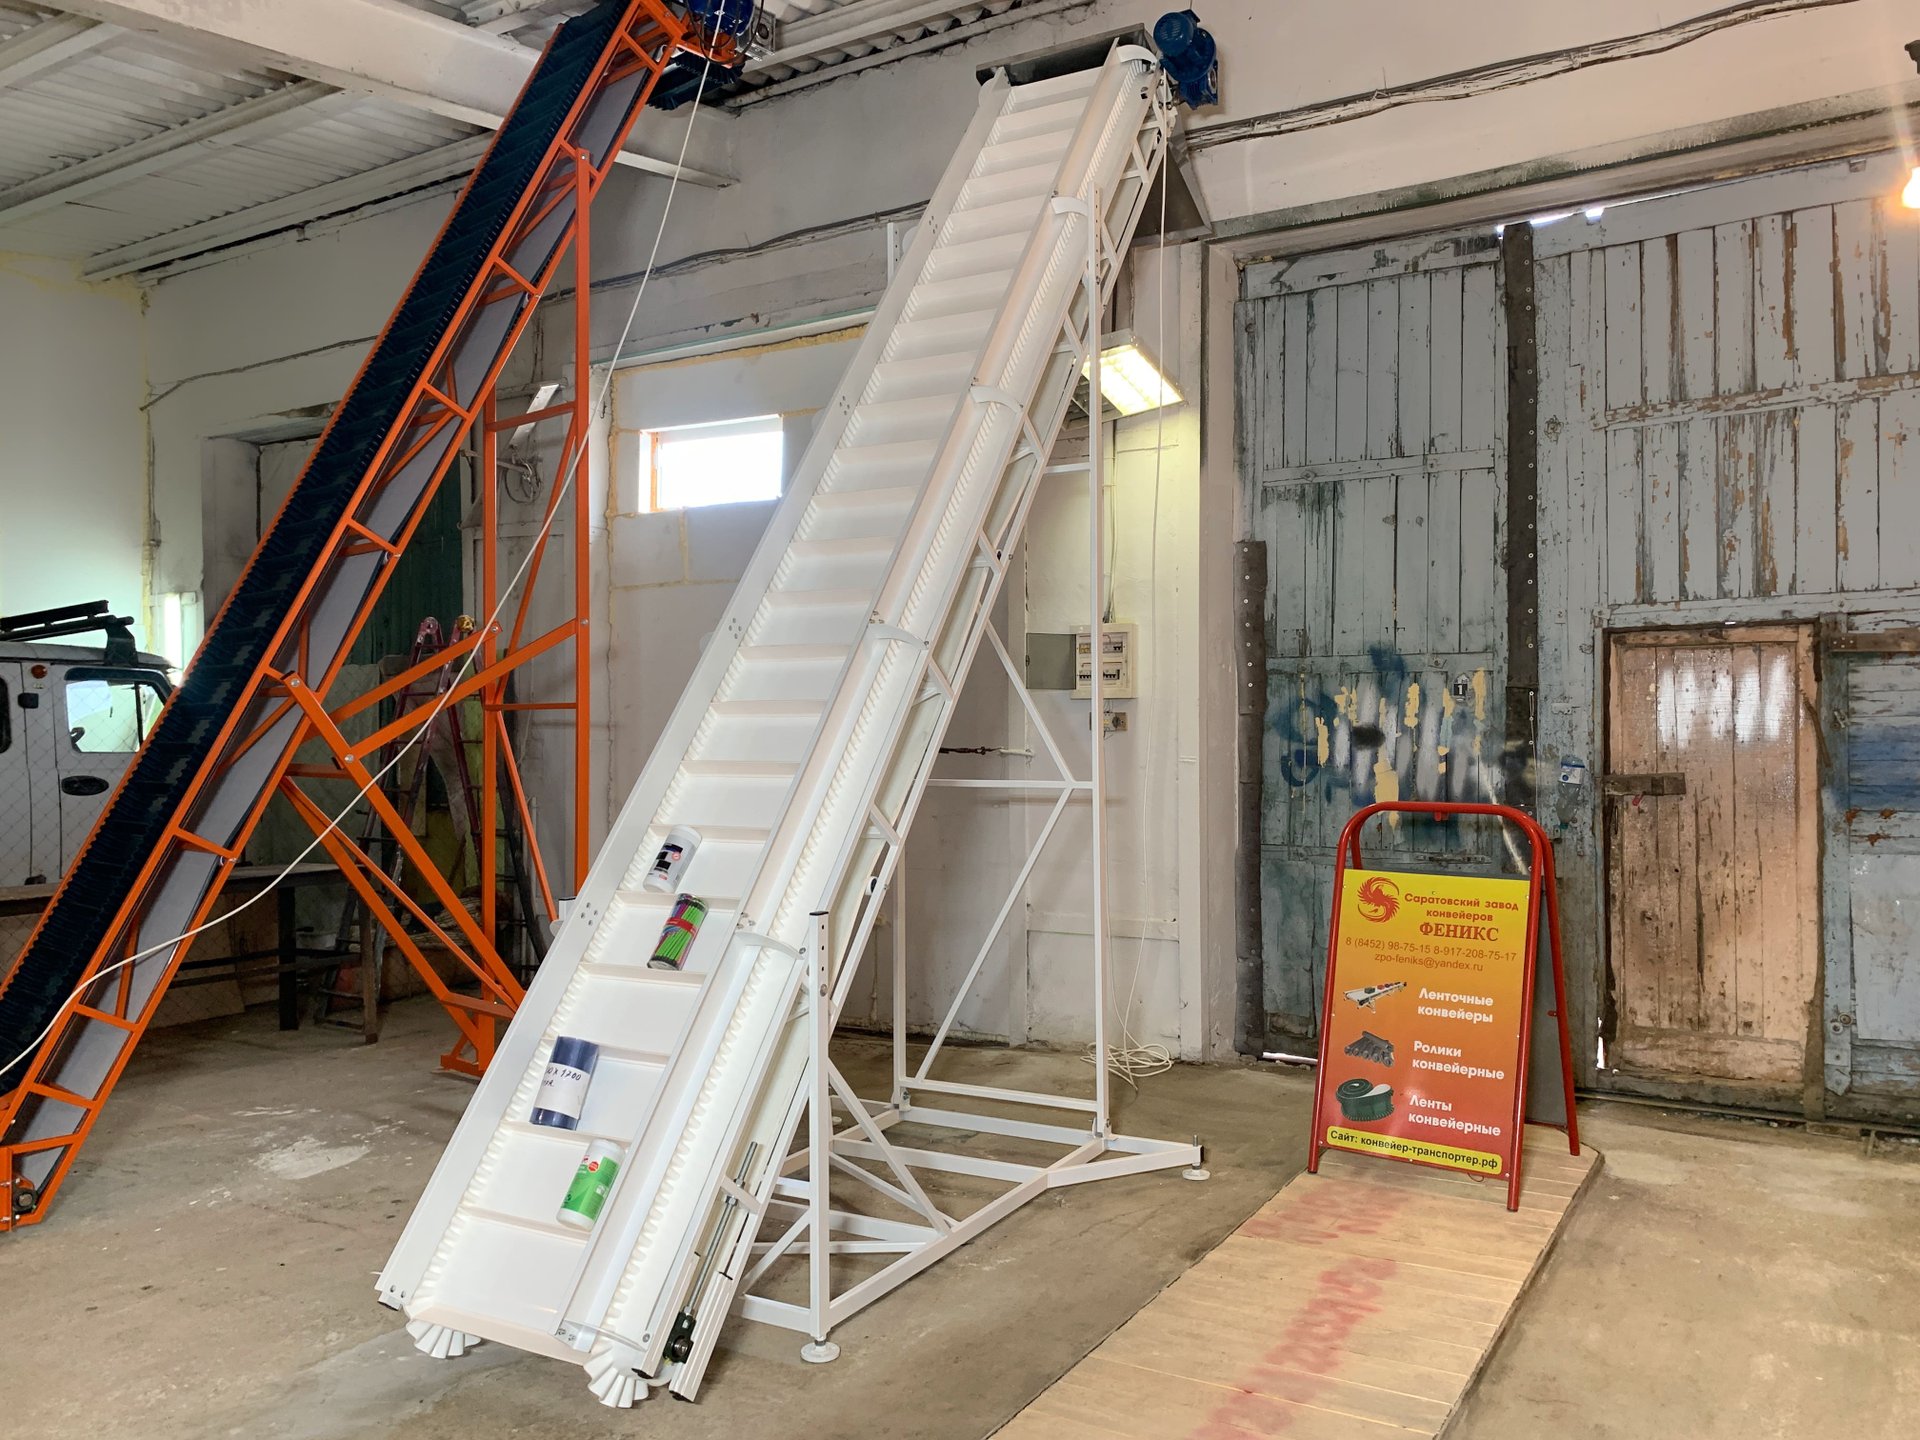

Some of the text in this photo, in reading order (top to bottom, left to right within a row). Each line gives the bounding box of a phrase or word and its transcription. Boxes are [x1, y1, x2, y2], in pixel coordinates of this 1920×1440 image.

[1404, 893, 1519, 911] Саратовский завод
[1426, 909, 1493, 922] конвейеров
[1419, 922, 1499, 942] ФЕНИКС
[1345, 937, 1517, 962] 8 (8452) 98-75-15 8-917-208-75-17
[1374, 953, 1484, 972] zpo-feniks@yandex.ru
[1419, 988, 1494, 1007] Ленточные
[1417, 1005, 1493, 1024] конвейеры
[1413, 1040, 1462, 1057] Ролики
[1412, 1058, 1505, 1080] конвейерные
[1409, 1095, 1452, 1112] Ленты
[1408, 1113, 1501, 1137] конвейерные
[1330, 1129, 1498, 1170] Сайт: конвейер-транспортер.рф
